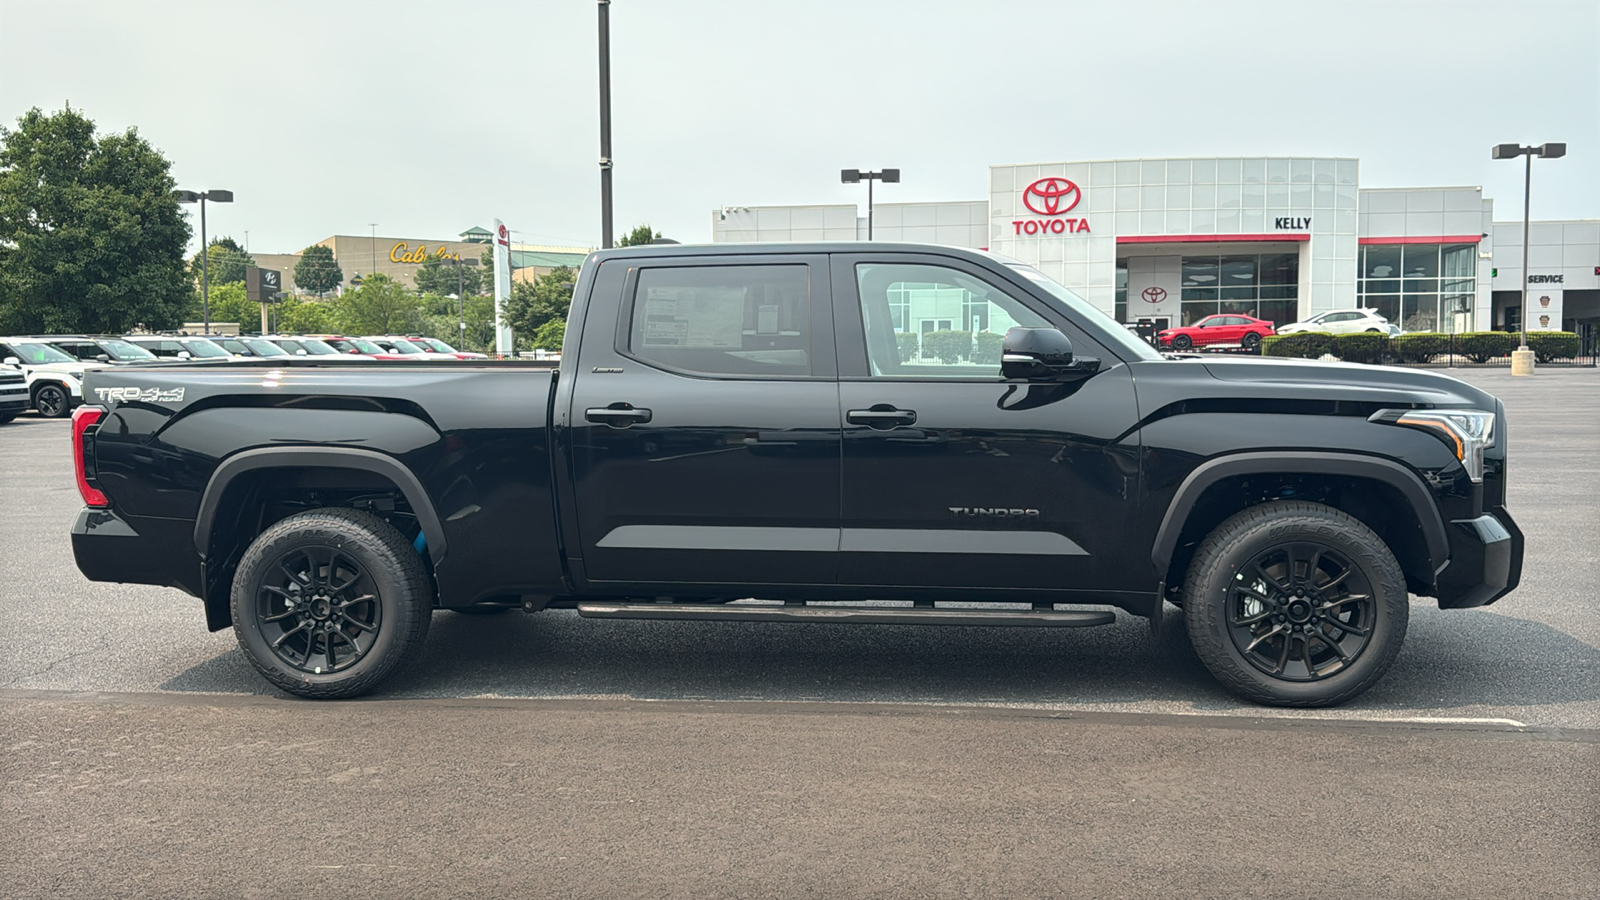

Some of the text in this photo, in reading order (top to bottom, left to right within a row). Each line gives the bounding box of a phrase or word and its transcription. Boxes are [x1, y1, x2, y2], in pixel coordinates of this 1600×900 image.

[1012, 218, 1091, 235] TOYOTA
[1275, 217, 1312, 230] KELLY
[1527, 274, 1564, 284] SERVICE
[94, 387, 141, 404] TRD
